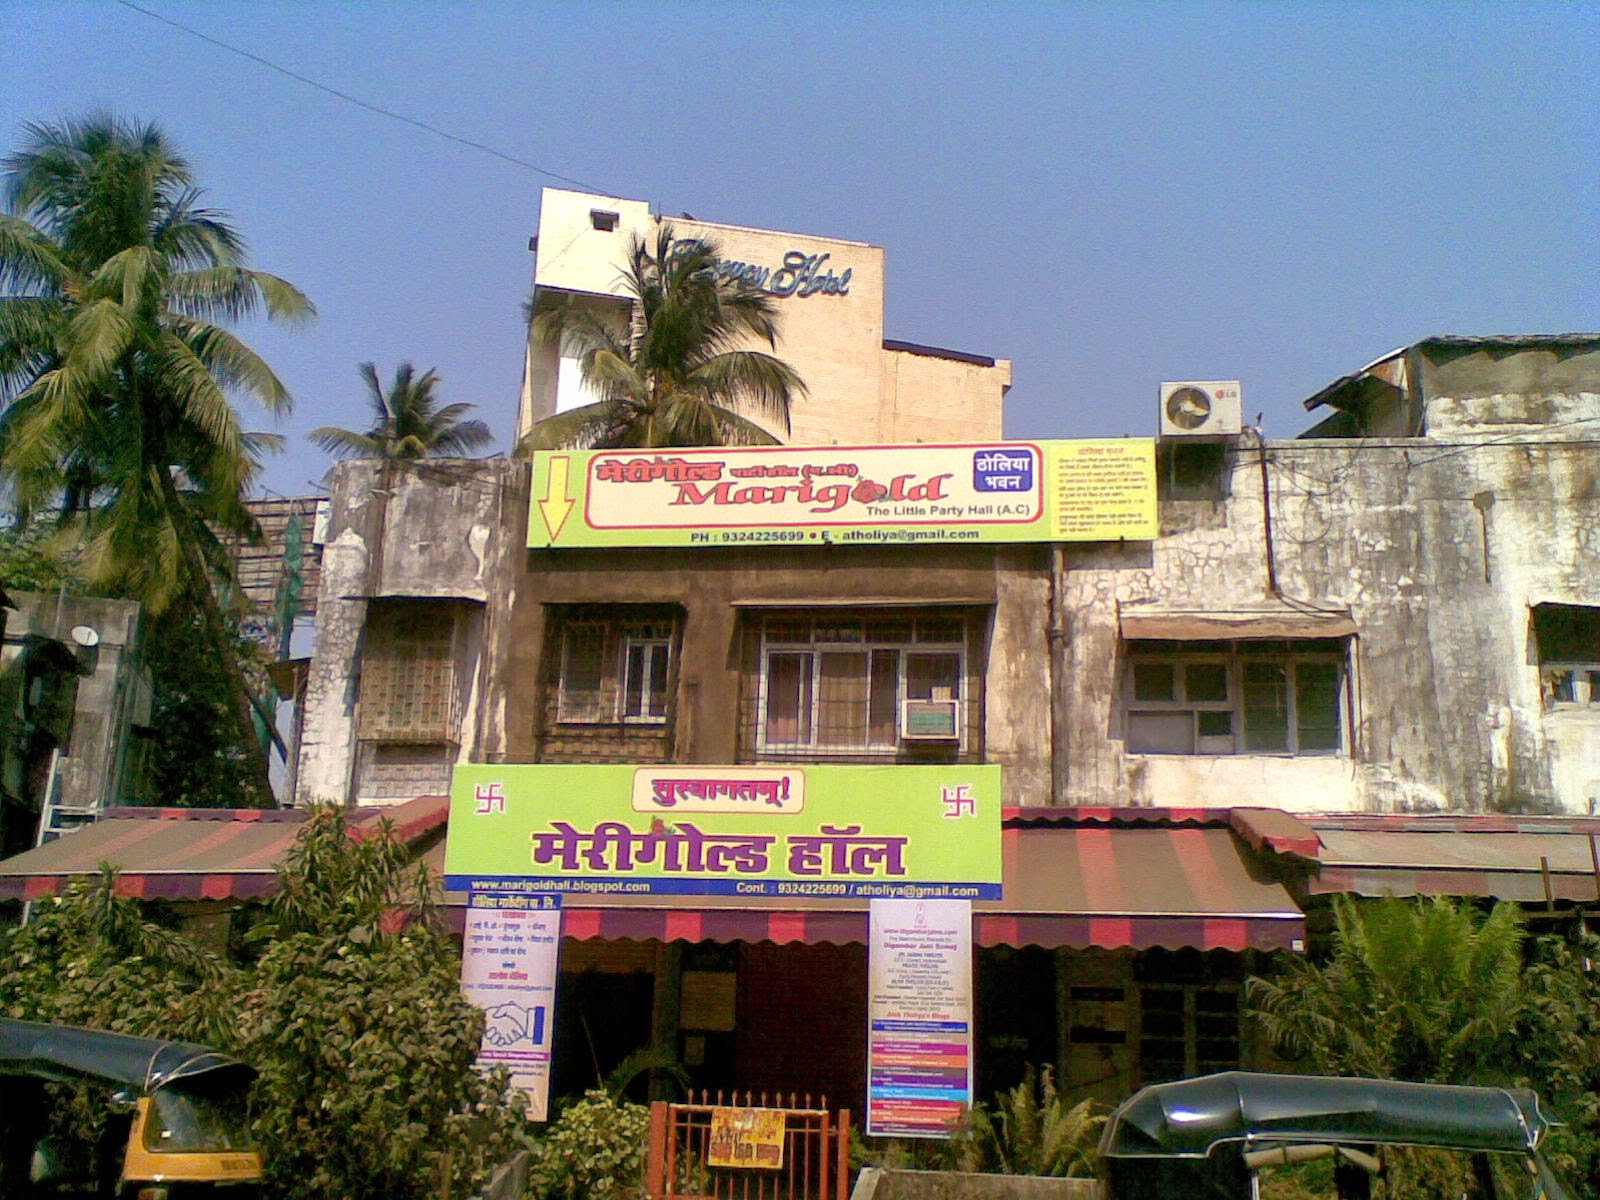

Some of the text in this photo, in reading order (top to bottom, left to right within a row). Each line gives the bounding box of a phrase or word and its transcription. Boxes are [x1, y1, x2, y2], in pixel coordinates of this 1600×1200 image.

[771, 250, 852, 299] Hotel
[1226, 391, 1237, 399] LG
[975, 452, 1031, 472] ठोलिया
[984, 475, 1022, 489] भवन
[667, 473, 954, 514] Marigold
[866, 504, 1031, 517] The Little Party Hall (A.C)
[690, 532, 710, 543] PH
[722, 531, 805, 542] 9324225699
[821, 530, 830, 541] E
[842, 529, 980, 542] atholiya@gmail.com
[650, 776, 791, 808] सुस्वागतम्!
[532, 821, 909, 876] मेरीगोल्ड हॉल
[471, 880, 651, 892] www.marigoldhall.blogspot.com
[855, 884, 979, 898] atholiya@gmail.com
